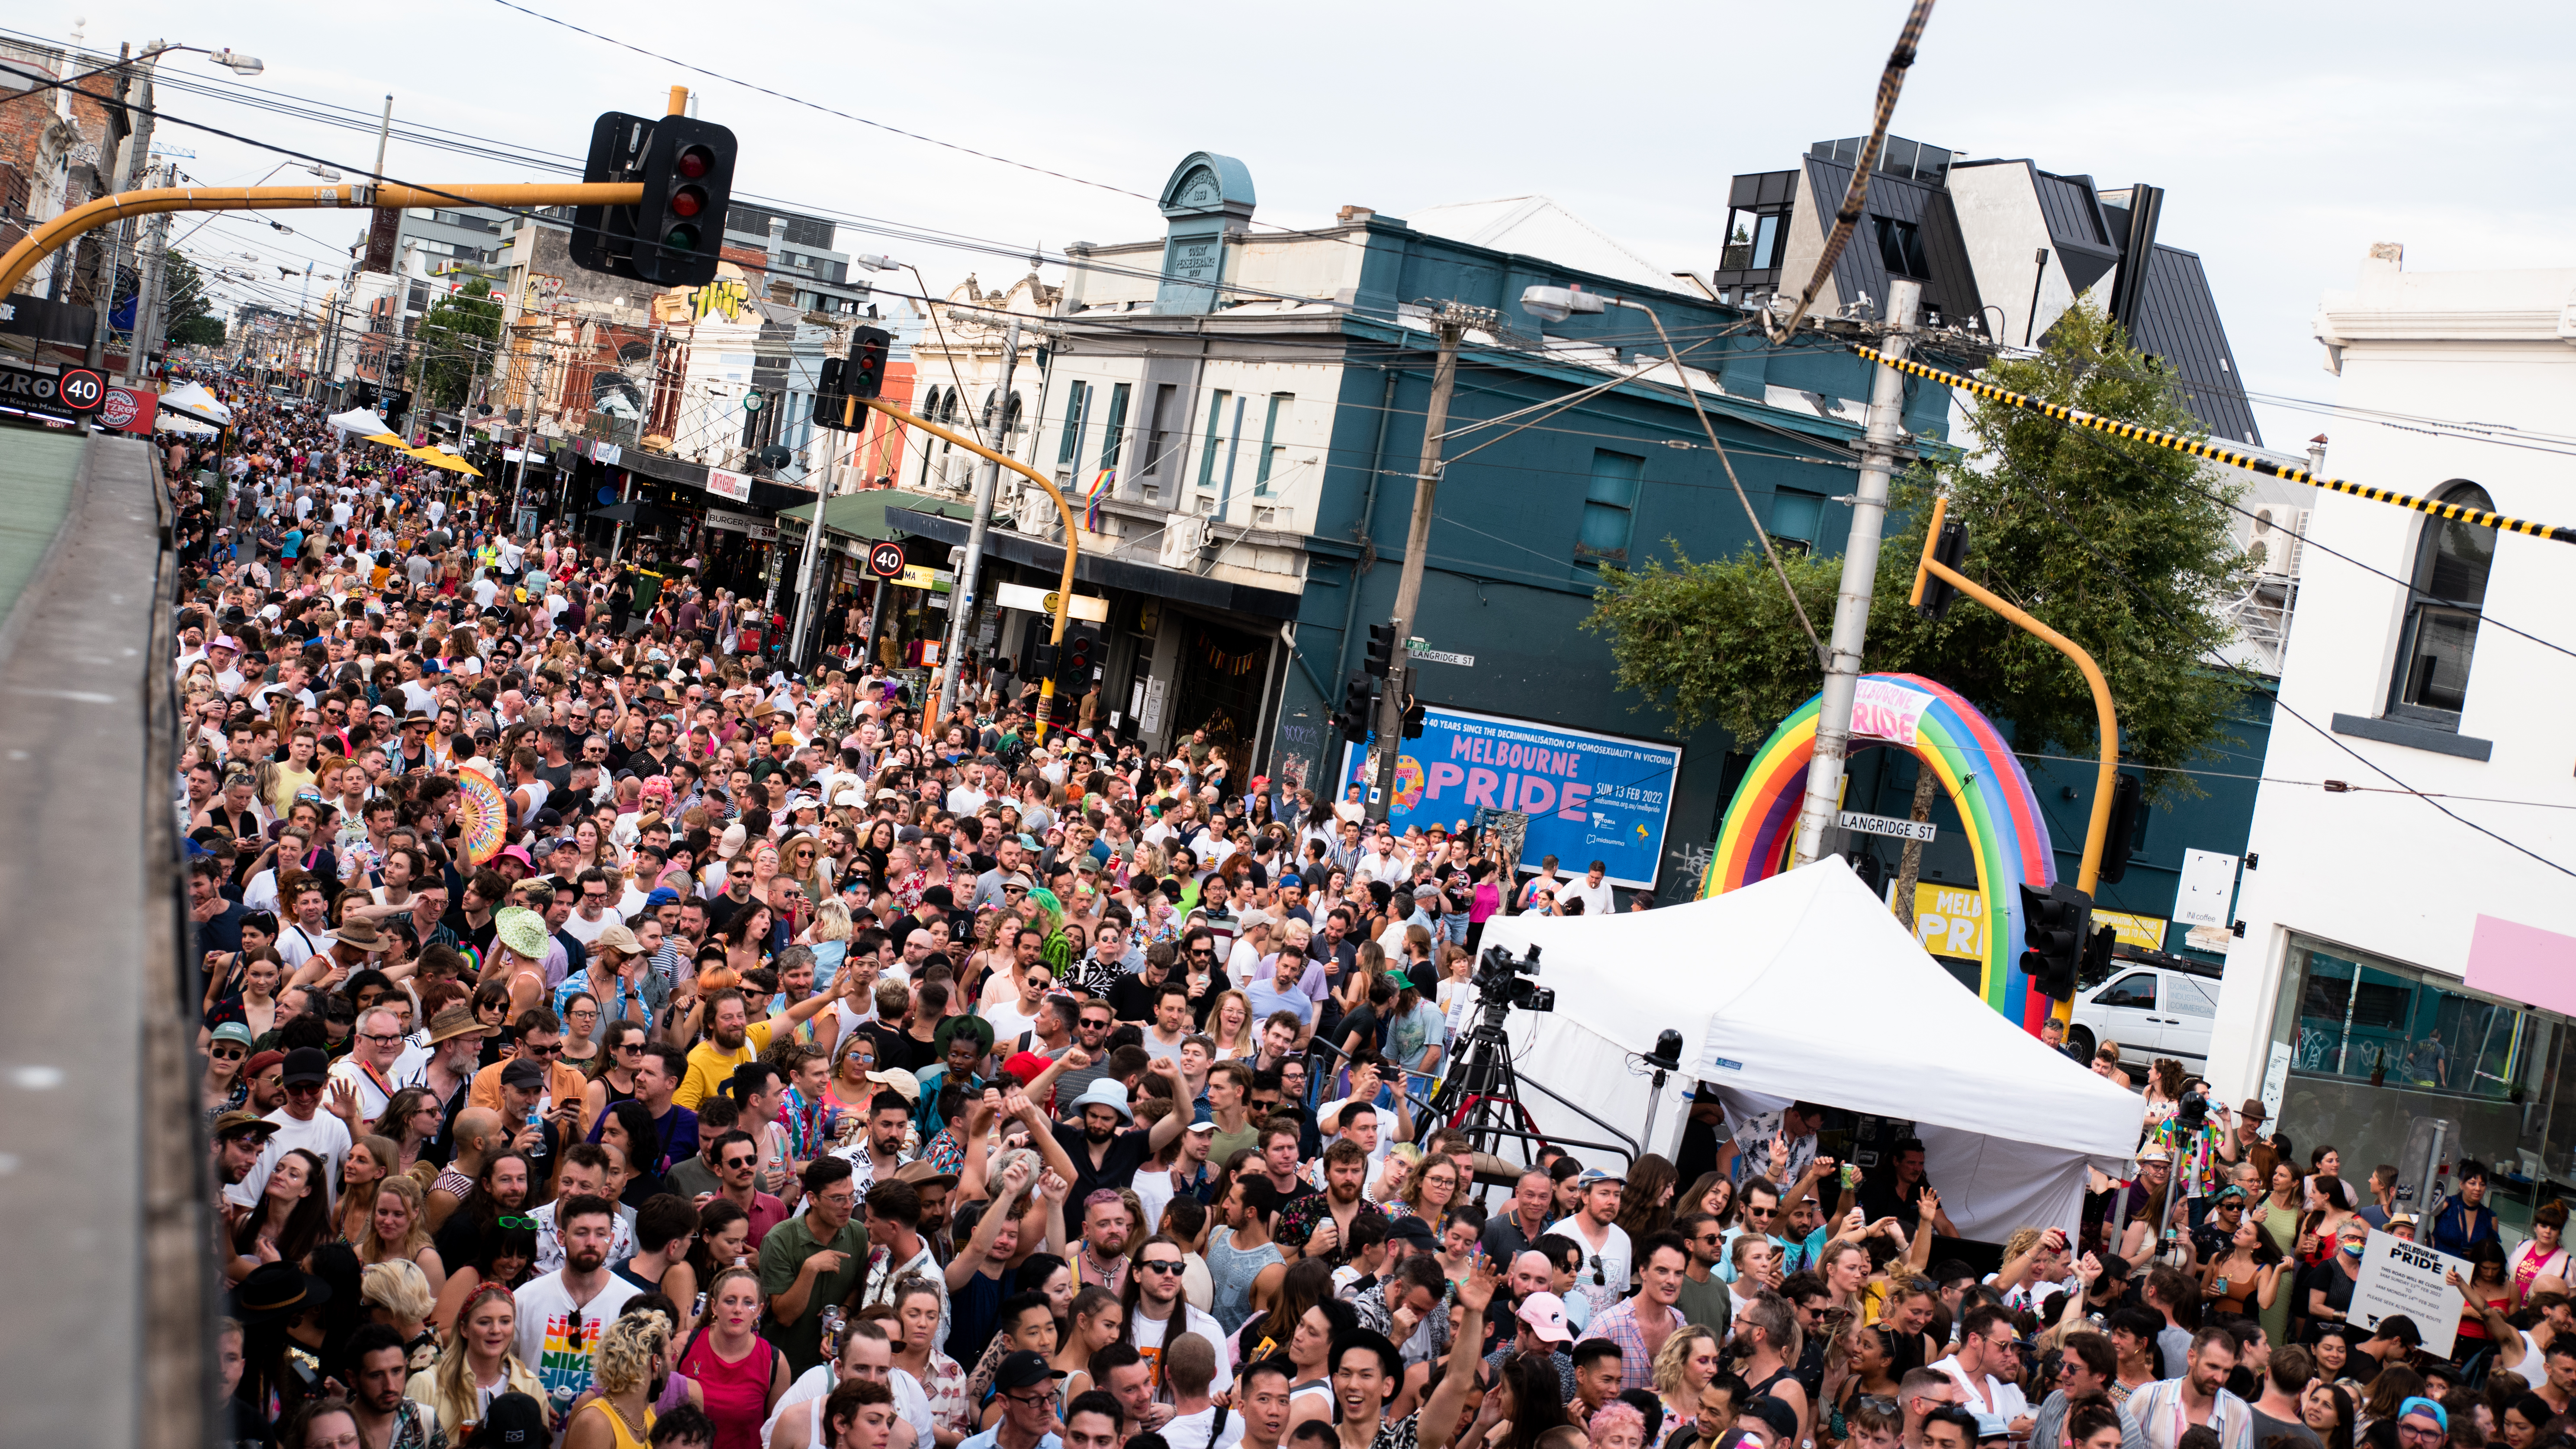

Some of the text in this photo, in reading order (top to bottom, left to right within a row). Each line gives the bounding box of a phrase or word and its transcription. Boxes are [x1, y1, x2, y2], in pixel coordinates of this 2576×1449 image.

[1189, 245, 1207, 257] COURT
[1176, 257, 1215, 269] PERSEVERANCE
[0, 371, 58, 398] ZRO
[67, 379, 97, 399] 40
[39, 402, 73, 414] MAKERS
[711, 472, 736, 495] SMITH KEBABS
[710, 514, 743, 527] BURGER
[876, 552, 898, 568] 40
[1412, 641, 1430, 652] SMITH ST
[1412, 650, 1458, 663] LANGRIDGE
[1852, 702, 1917, 742] RIDE
[1420, 717, 1672, 765] G 40 YEARS SINCE THE DECRIMINALISATION OF HOMOSEXUALITY IN VICTORIA
[1450, 734, 1581, 778] MELBOURNE
[1425, 761, 1592, 822] PRIDE
[1596, 782, 1663, 804] SUN 13 FEB 2022
[1594, 797, 1660, 813] midsumma.org.au/melbpride
[1841, 814, 1933, 839] LANGRIDGE ST
[1596, 837, 1625, 846] midsumma
[1936, 890, 1982, 917] MELB
[2091, 912, 2157, 930] OMMEMORATING 40 YEARS
[2196, 913, 2216, 922] coffee
[2116, 926, 2155, 940] ROAD TO PRIDE
[2170, 982, 2203, 994] DOMESTIC
[2171, 992, 2209, 1005] INDUSTRIAL
[2171, 1001, 2214, 1015] COMMERCIAL
[2398, 1241, 2440, 1262] MELBOURNE
[2389, 1247, 2443, 1275] PRIDE
[2390, 1276, 2410, 1286] SUNDAY
[2392, 1269, 2405, 1278] ROAD
[2406, 1273, 2418, 1282] WILL
[2425, 1280, 2443, 1291] CLOSED
[2386, 1287, 2408, 1298] MONDAY
[2427, 1301, 2440, 1310] 2022
[2367, 1293, 2383, 1303] PLEASE
[2395, 1302, 2425, 1318] ALTERNATIVE
[2425, 1313, 2442, 1324] ROUTE
